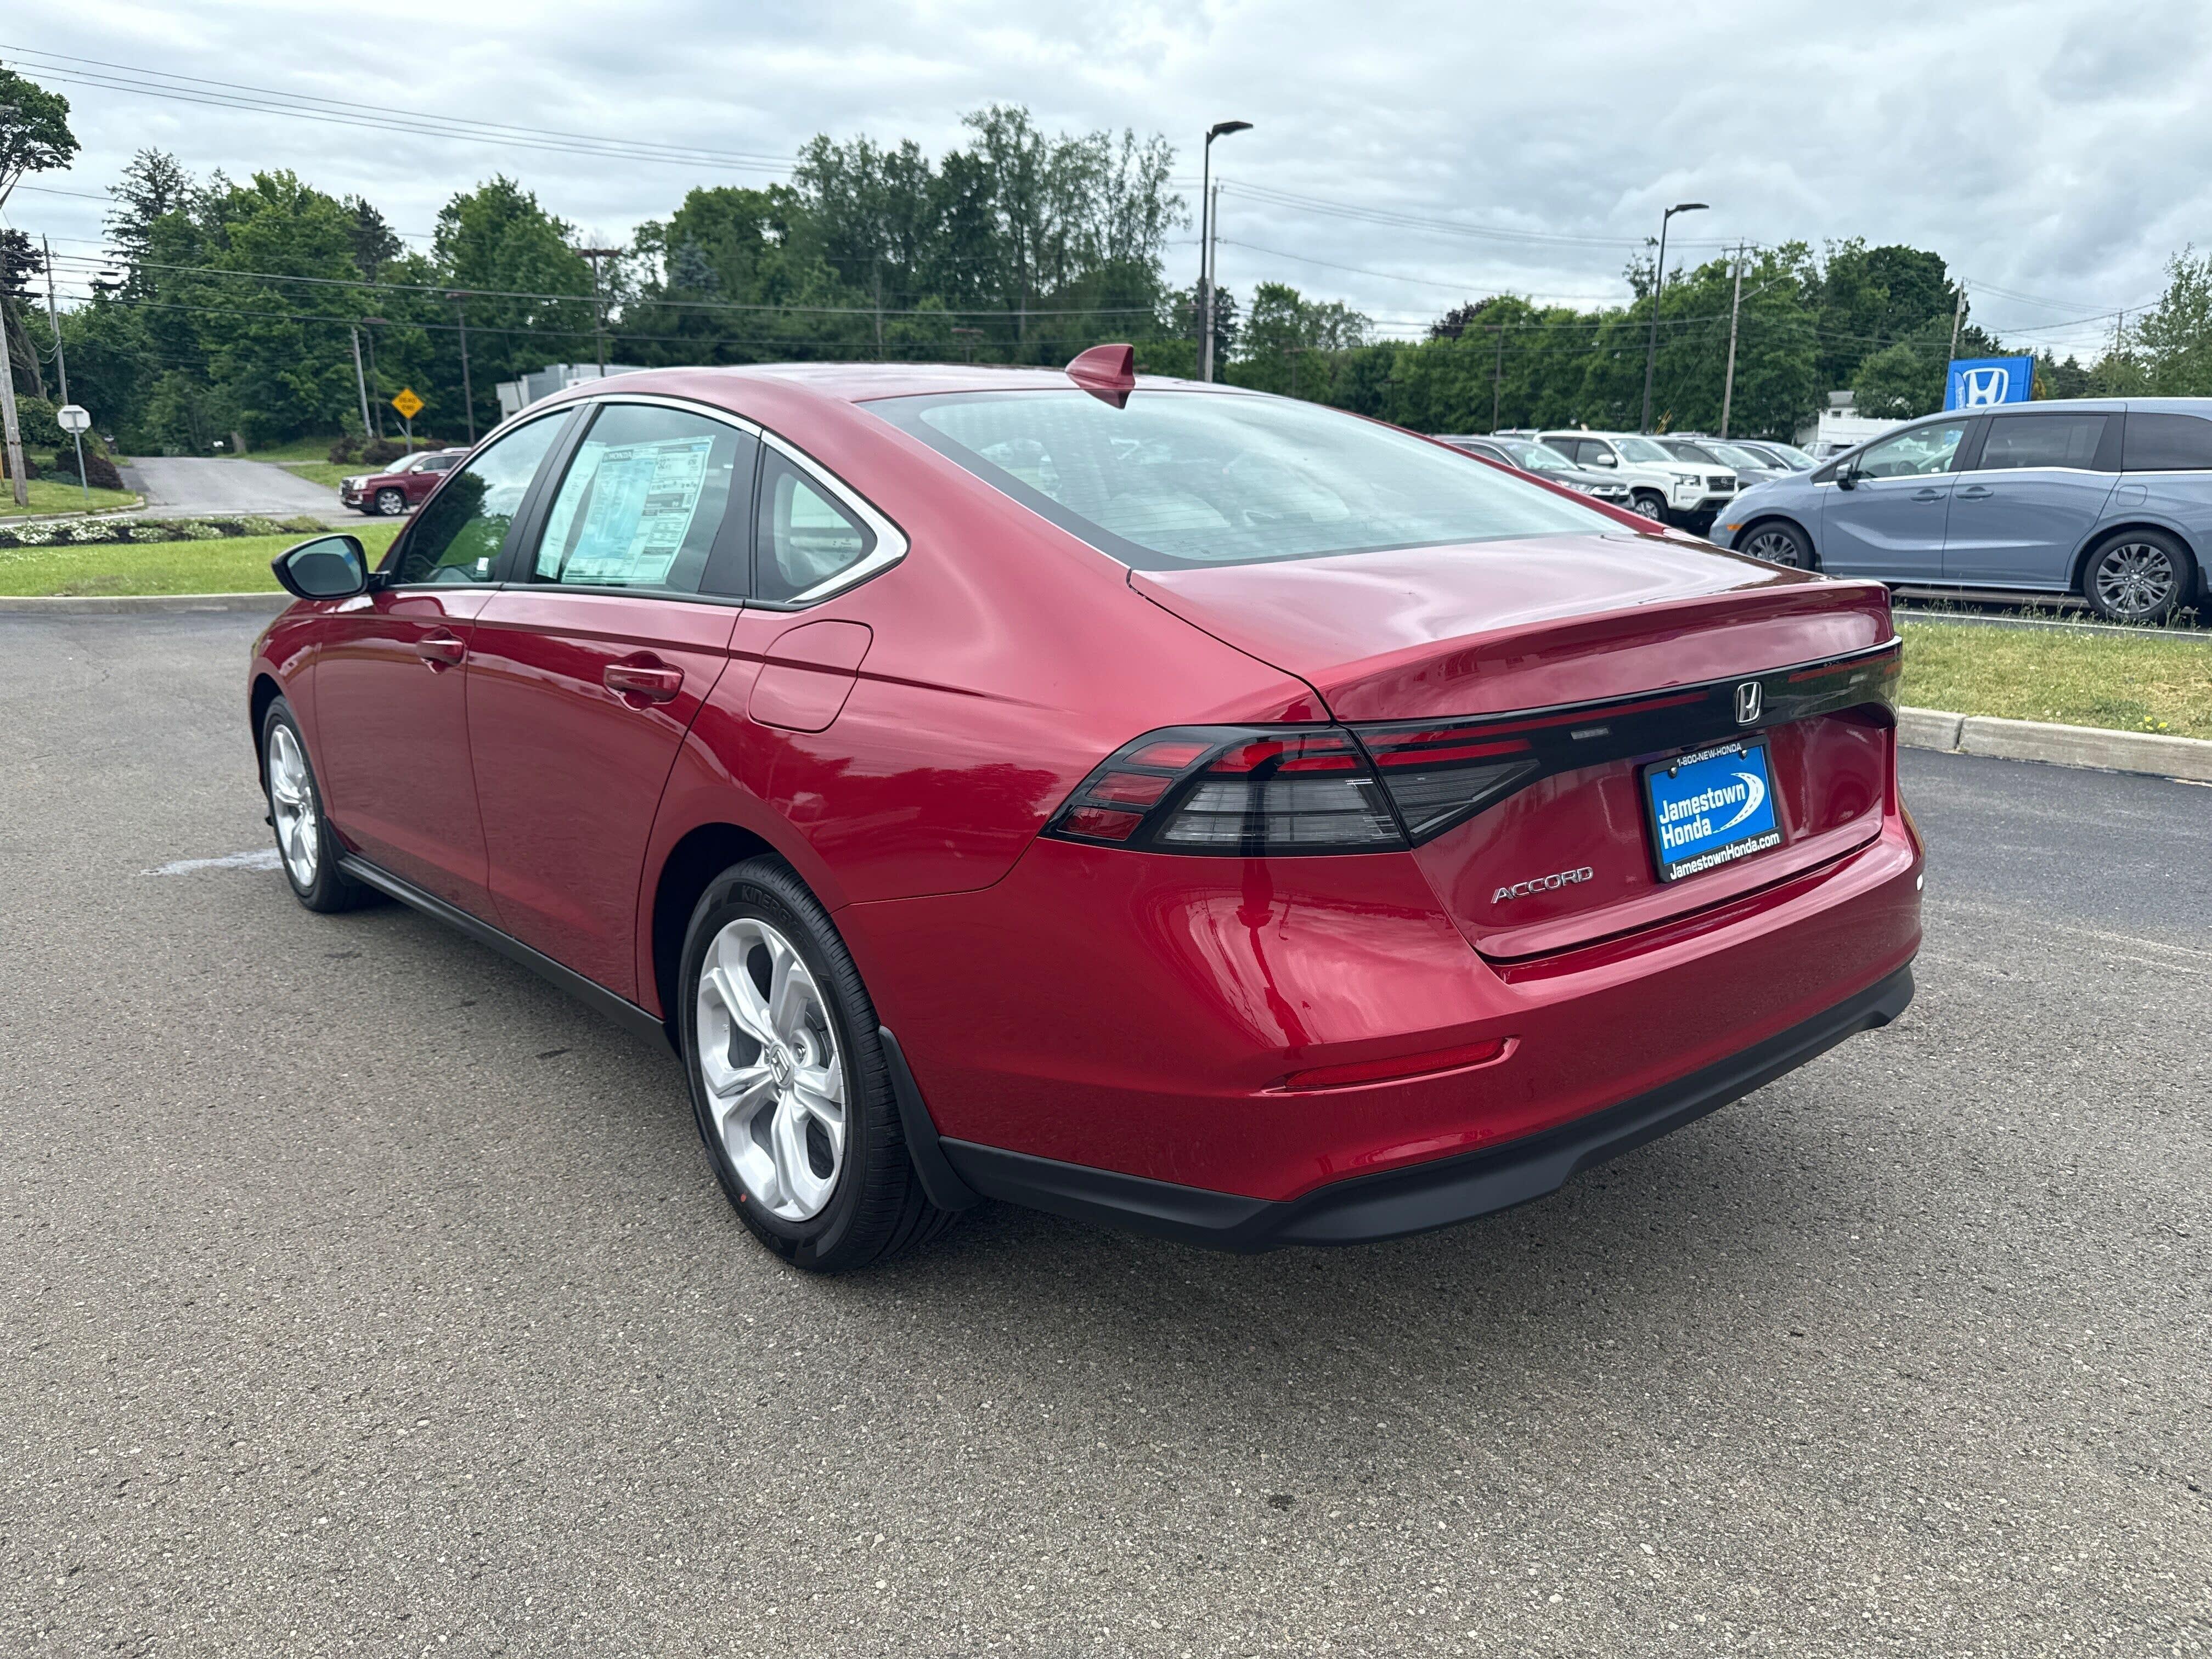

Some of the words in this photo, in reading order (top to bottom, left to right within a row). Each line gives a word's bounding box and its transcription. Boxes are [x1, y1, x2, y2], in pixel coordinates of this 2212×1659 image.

[1677, 742, 1742, 767] 1-800-NEW-HONDA
[1659, 783, 1746, 824] Jamestown
[1661, 815, 1712, 849] Honda
[1670, 833, 1780, 880] JamestownHonda.com
[1491, 866, 1594, 904] ACCORD
